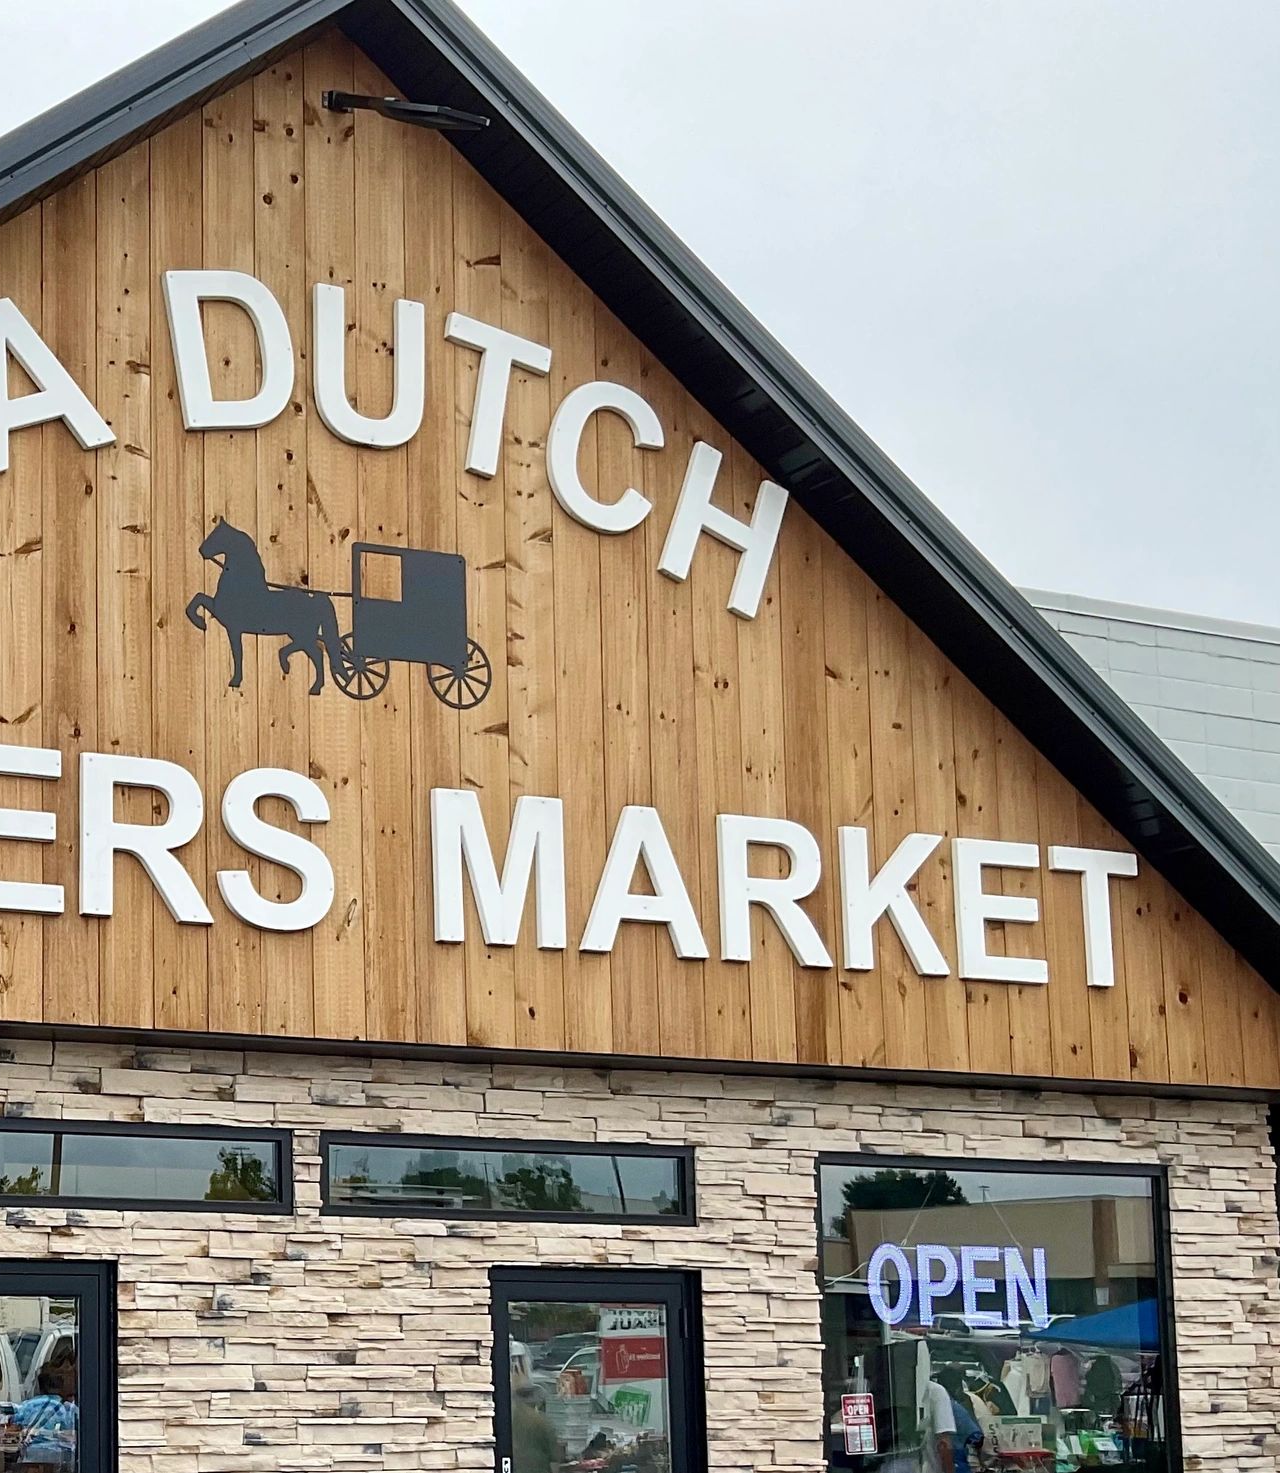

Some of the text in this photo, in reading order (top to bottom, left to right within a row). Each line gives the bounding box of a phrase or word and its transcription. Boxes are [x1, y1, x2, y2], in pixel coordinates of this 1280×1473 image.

[162, 269, 789, 620] DUTCH
[430, 788, 1138, 988] MARKET
[867, 1242, 1048, 1329] OPEN
[847, 1404, 869, 1415] OPEN
